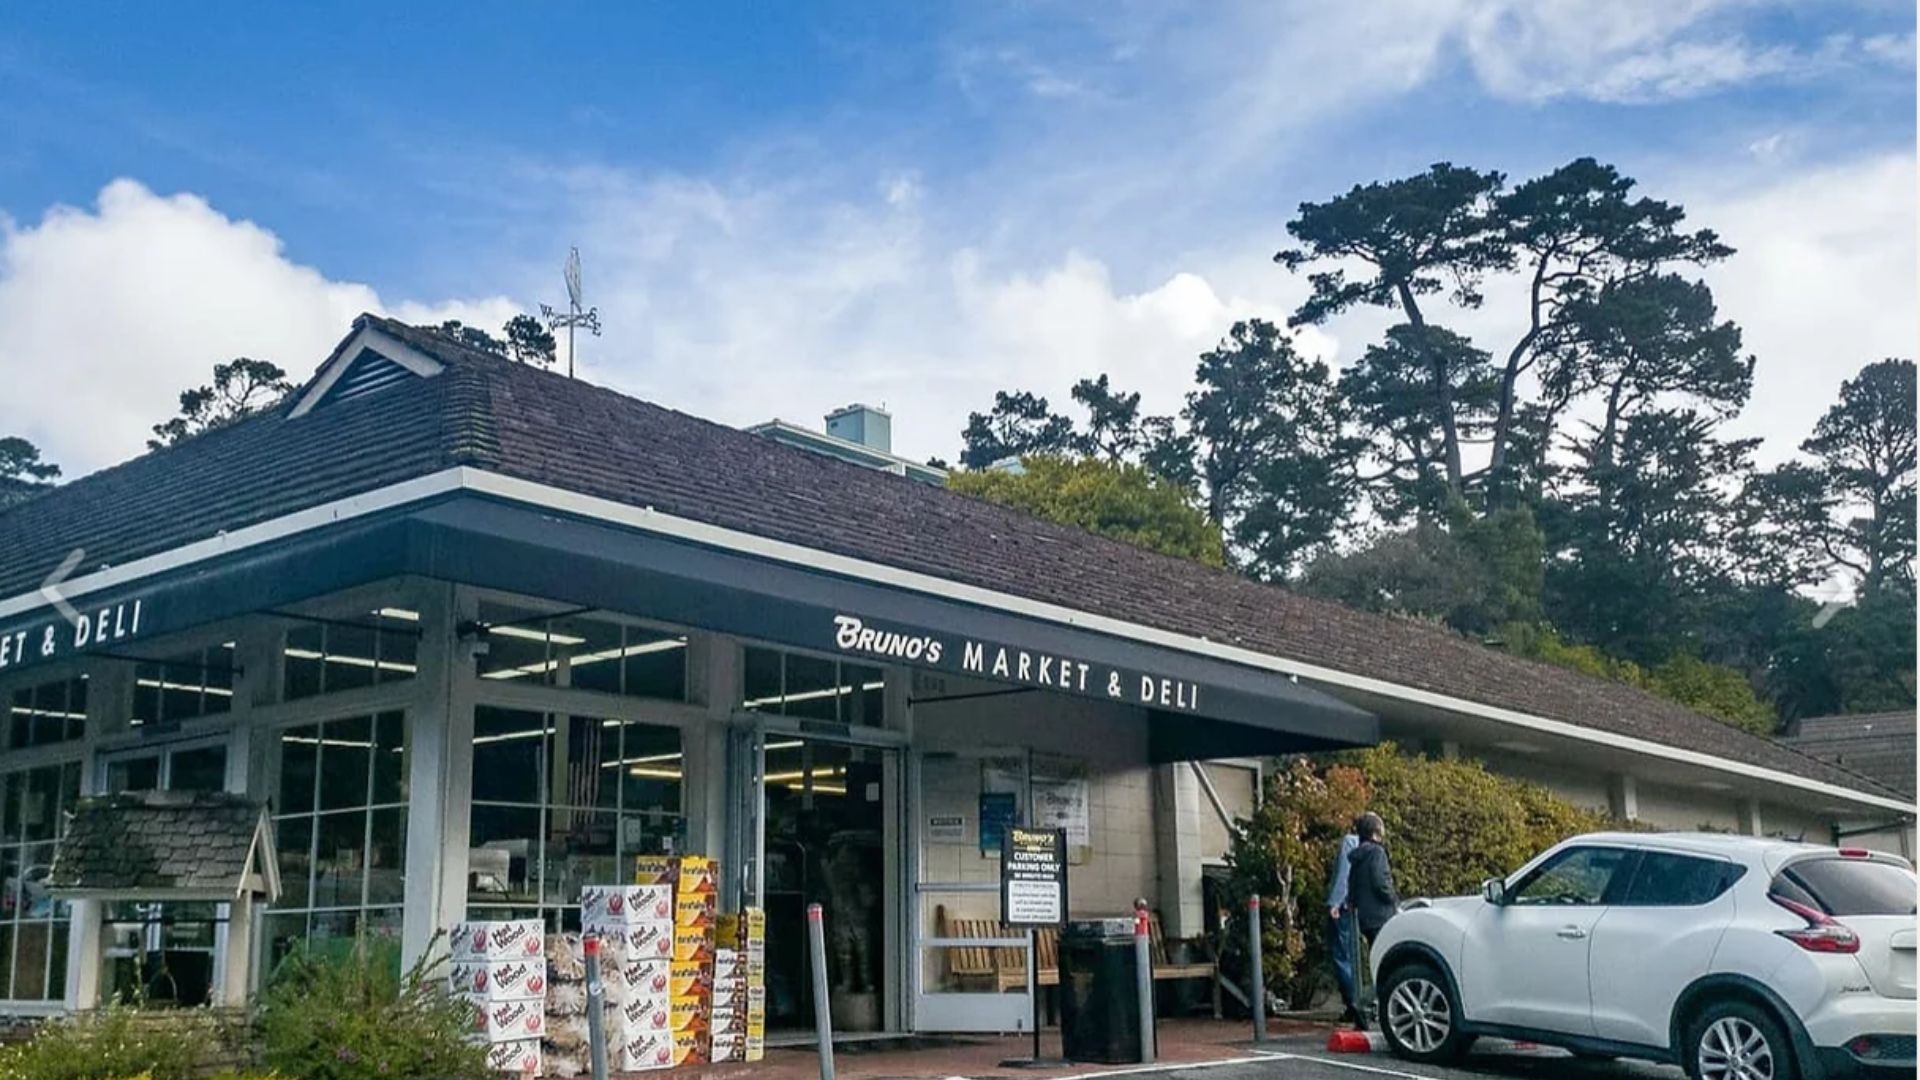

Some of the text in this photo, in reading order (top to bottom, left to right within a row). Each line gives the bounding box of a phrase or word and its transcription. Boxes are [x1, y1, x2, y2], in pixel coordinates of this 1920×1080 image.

[41, 624, 56, 657] &
[74, 600, 141, 648] DELI
[963, 641, 1089, 691] MARKET
[1107, 670, 1121, 697] &
[1141, 675, 1197, 709] DELI
[1007, 862, 1060, 872] PARKING ONLY
[493, 963, 512, 981] Hot
[493, 1003, 512, 1020] Hot
